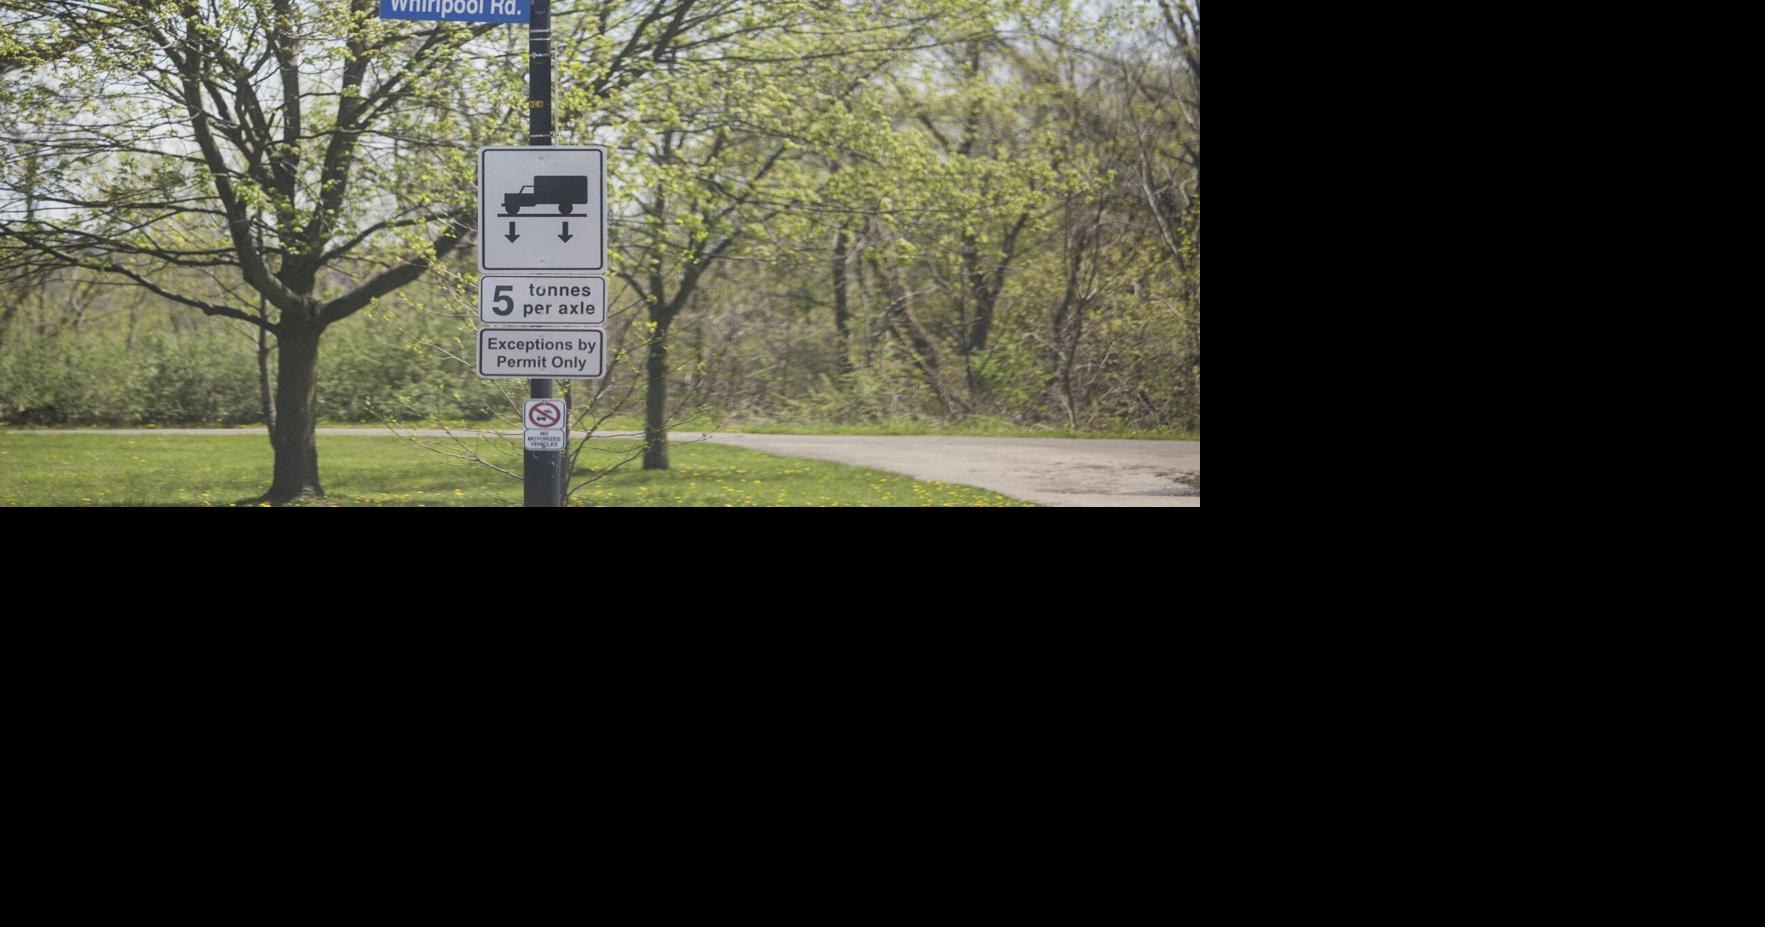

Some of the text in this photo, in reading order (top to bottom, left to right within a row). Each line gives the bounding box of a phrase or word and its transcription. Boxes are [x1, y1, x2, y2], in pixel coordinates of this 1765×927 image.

[391, 0, 521, 18] Whirlpool Rd.
[529, 283, 591, 297] tonnes
[492, 285, 514, 316] 5
[523, 301, 596, 318] per axle
[487, 337, 596, 354] Exceptions by
[496, 355, 587, 371] Permit Only
